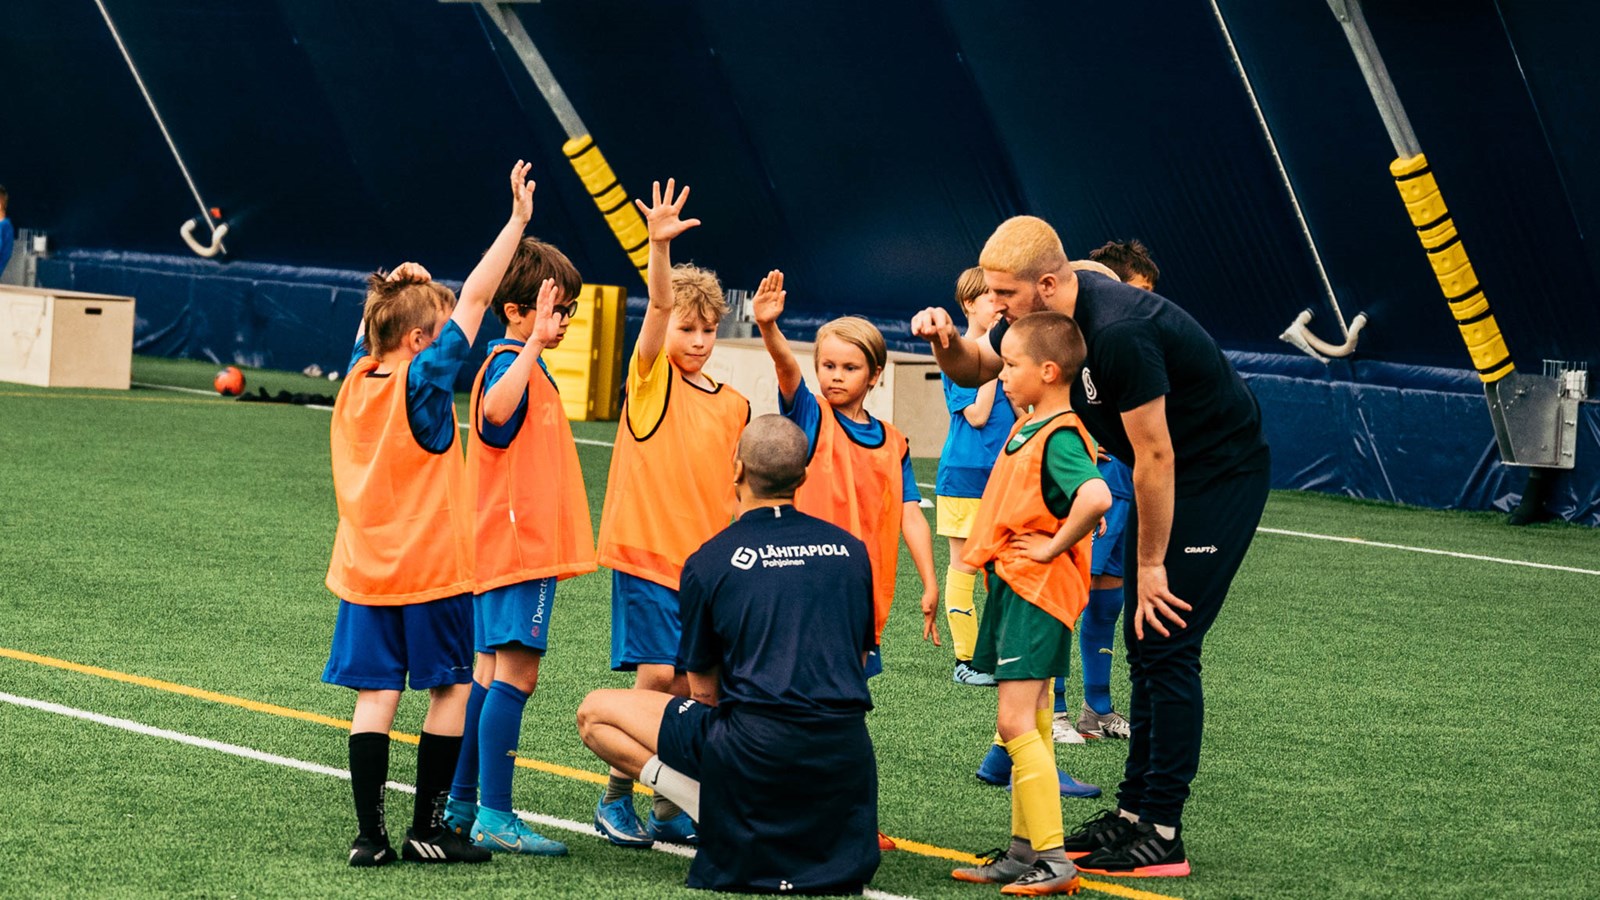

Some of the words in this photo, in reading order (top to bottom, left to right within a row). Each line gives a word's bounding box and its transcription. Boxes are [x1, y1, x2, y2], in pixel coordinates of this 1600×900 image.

[758, 544, 850, 559] LÄHITAPIOLA
[1184, 546, 1212, 554] CRAFT
[762, 559, 805, 568] Pohjoinen
